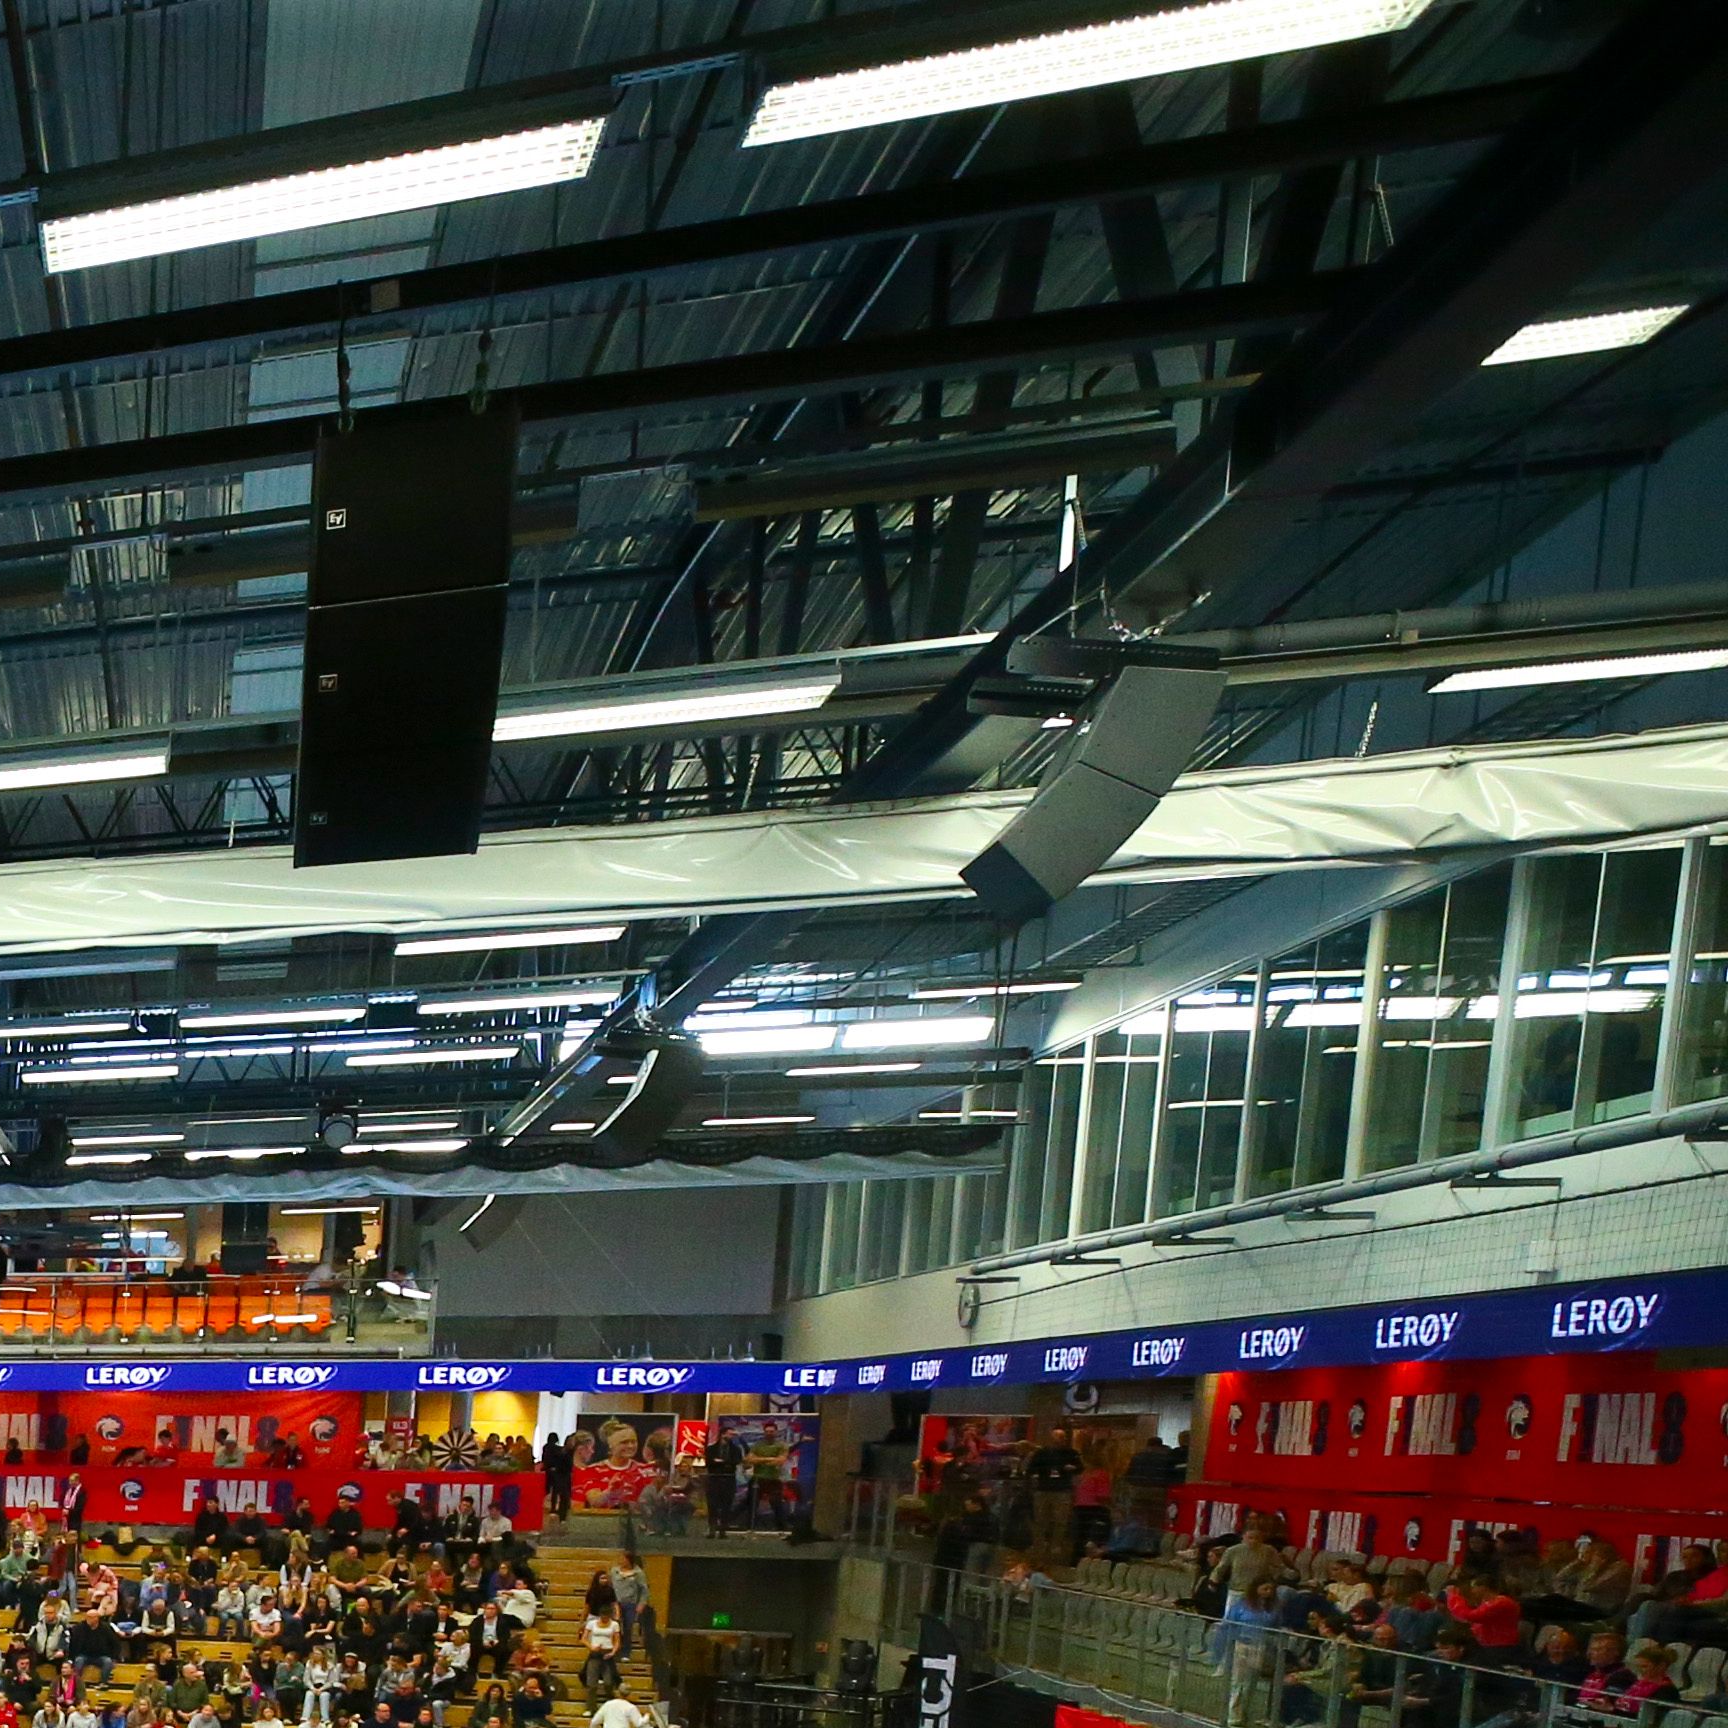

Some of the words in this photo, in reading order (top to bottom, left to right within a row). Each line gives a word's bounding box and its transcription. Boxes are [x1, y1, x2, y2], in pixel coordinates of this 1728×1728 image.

[1551, 1293, 1658, 1338] LERØY
[1375, 1312, 1459, 1349] LERØY
[1132, 1337, 1185, 1366] LERØY
[1240, 1326, 1304, 1359] LERØY
[971, 1354, 1008, 1377] LERØY
[1045, 1345, 1087, 1372] LERØY
[86, 1367, 166, 1385] LERØY
[248, 1366, 332, 1384] LERØY
[419, 1366, 506, 1385] LERØY
[596, 1367, 687, 1386] LERØY
[858, 1365, 885, 1385] LERØY
[911, 1360, 942, 1381] LERØY
